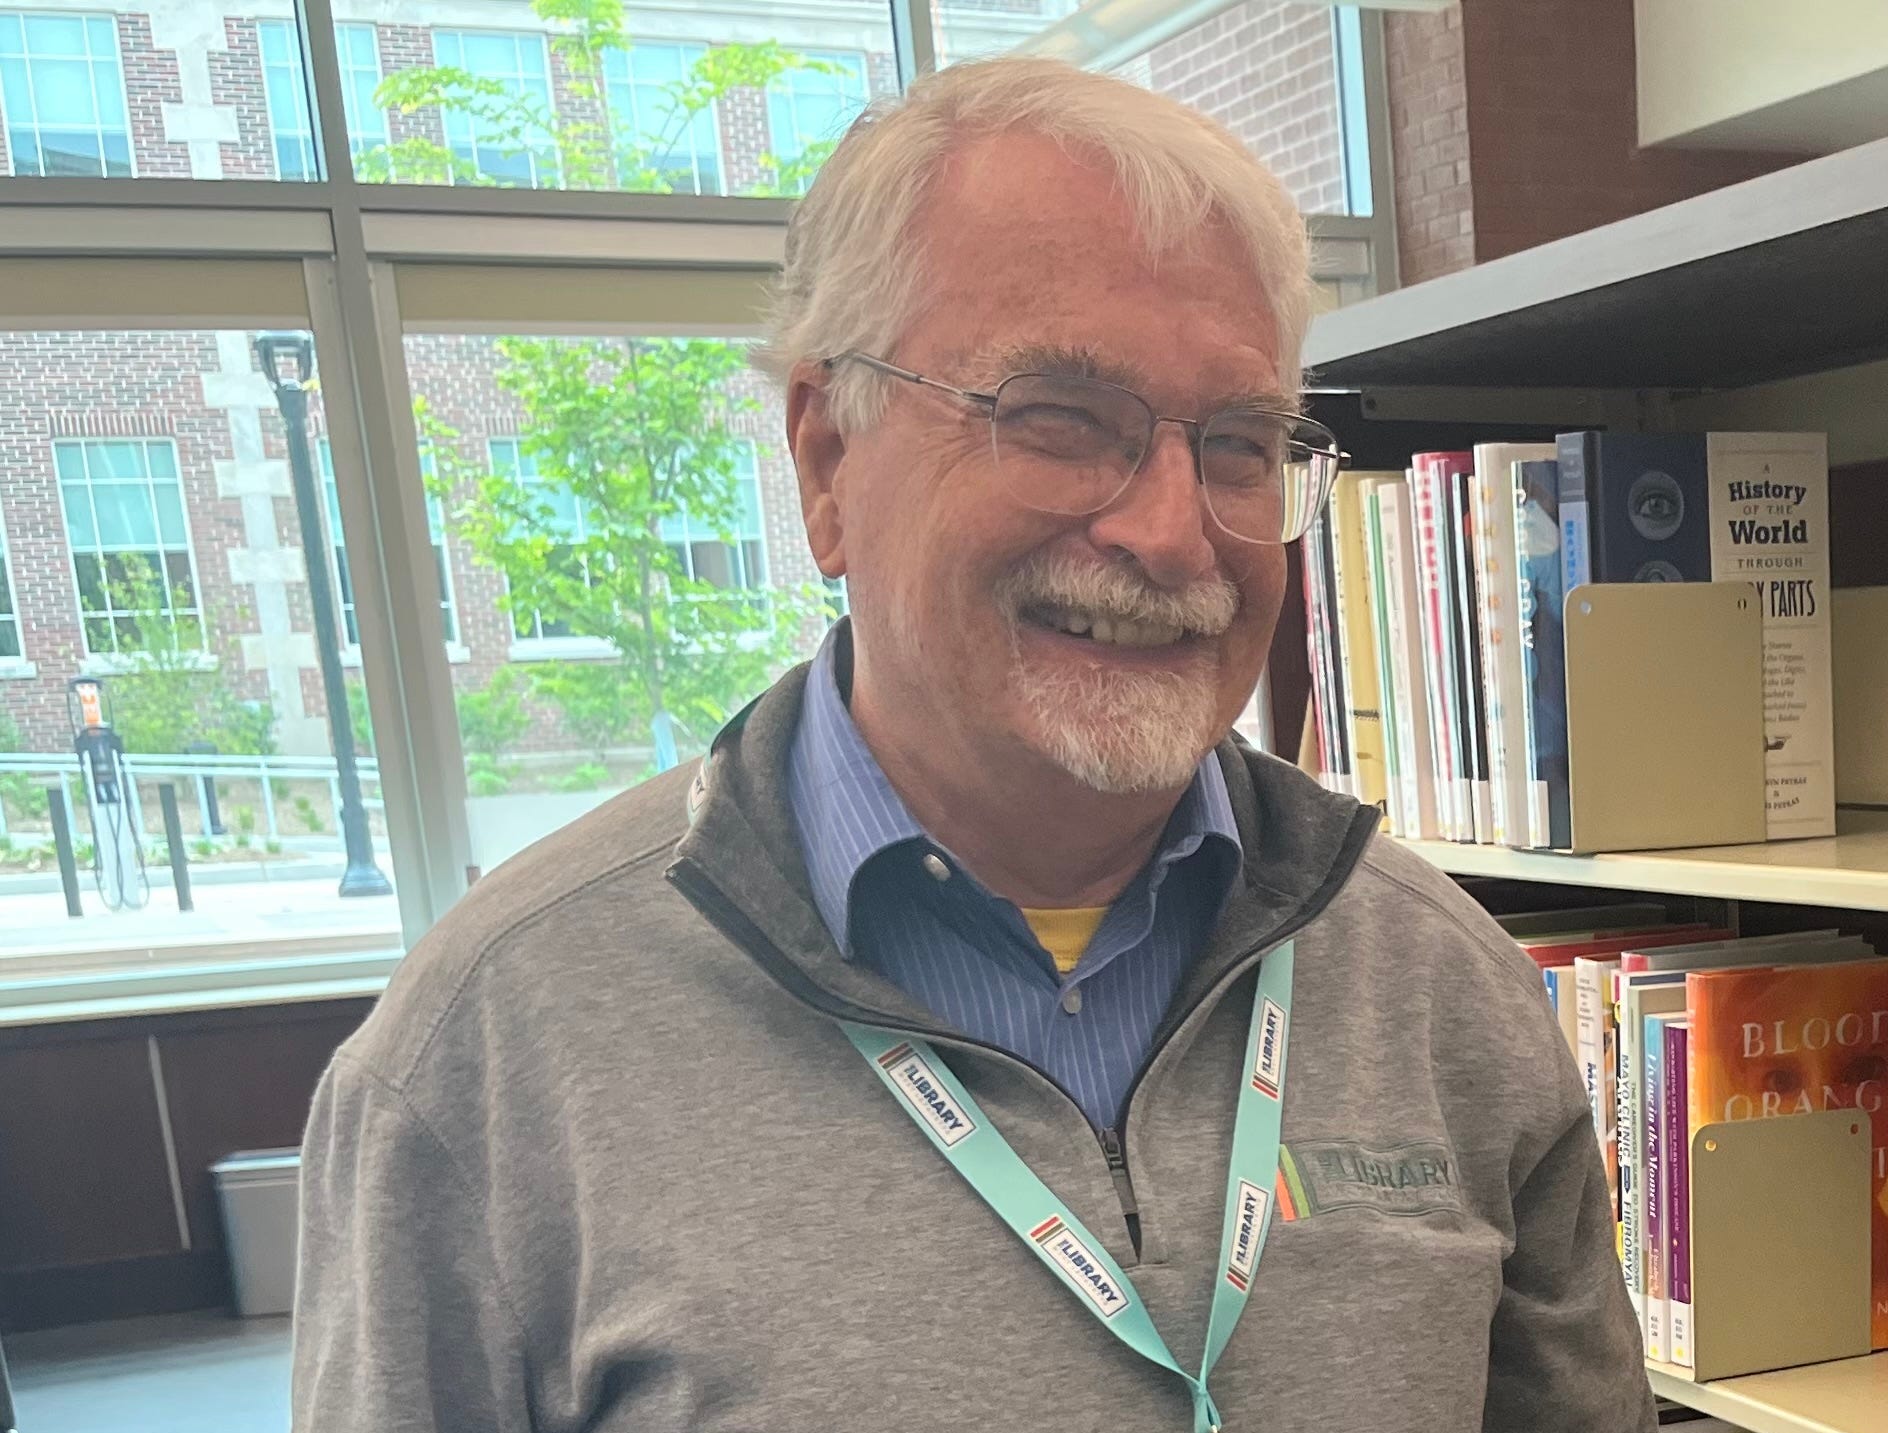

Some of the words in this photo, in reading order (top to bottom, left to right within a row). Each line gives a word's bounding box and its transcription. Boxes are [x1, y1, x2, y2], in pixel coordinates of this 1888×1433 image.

[1728, 481, 1807, 504] History
[1729, 520, 1809, 544] World
[1737, 556, 1804, 569] THROUGH
[1770, 580, 1816, 617] PARTS
[1261, 1005, 1278, 1067] LIBRARY
[906, 1063, 962, 1133] LIBRARY
[1336, 1156, 1454, 1189] LIBRARY
[1236, 1190, 1259, 1258] LIBRARY
[1058, 1236, 1117, 1305] LIBRARY
